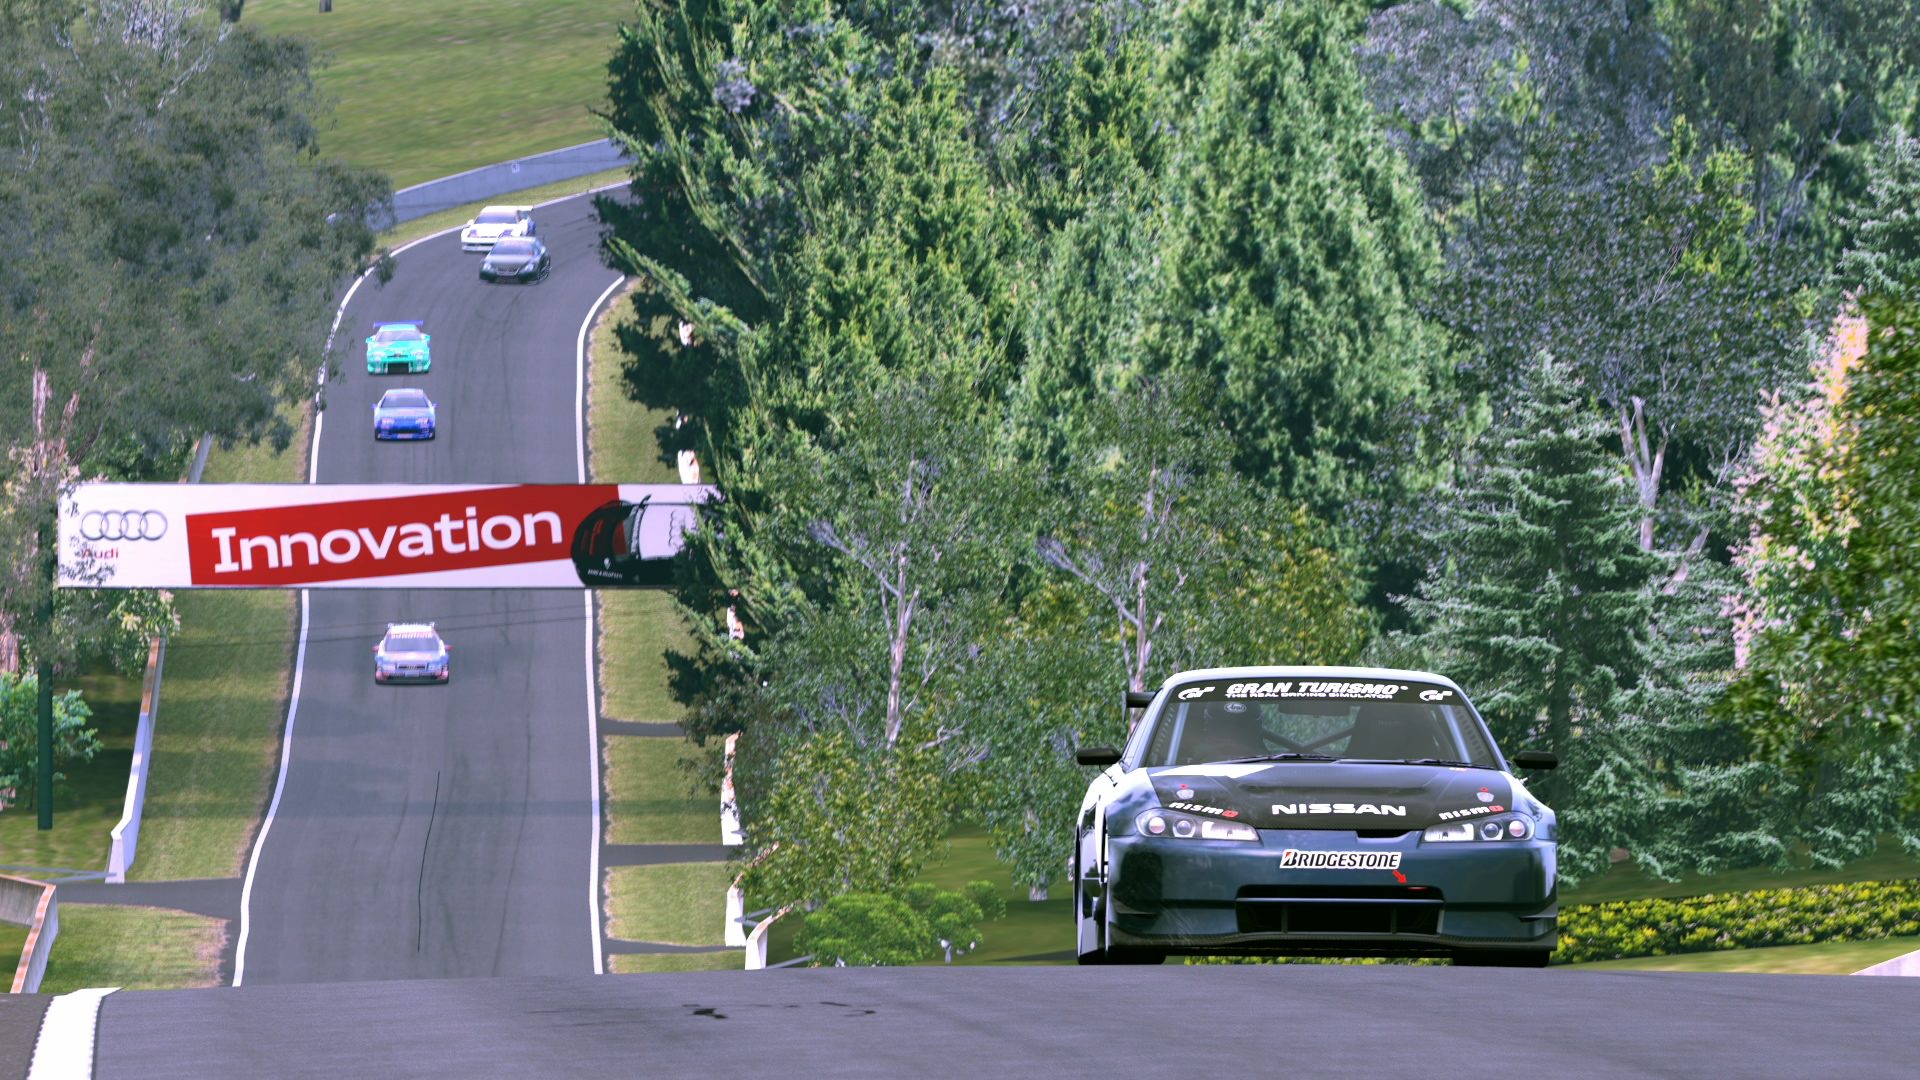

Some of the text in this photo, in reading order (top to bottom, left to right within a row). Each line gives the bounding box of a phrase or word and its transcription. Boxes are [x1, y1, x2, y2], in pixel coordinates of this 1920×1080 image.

[211, 506, 563, 574] Innovation
[1226, 682, 1399, 694] GRAN TURISMO
[1271, 803, 1407, 816] NISSAN
[1283, 851, 1399, 868] BRIDGESTONE
